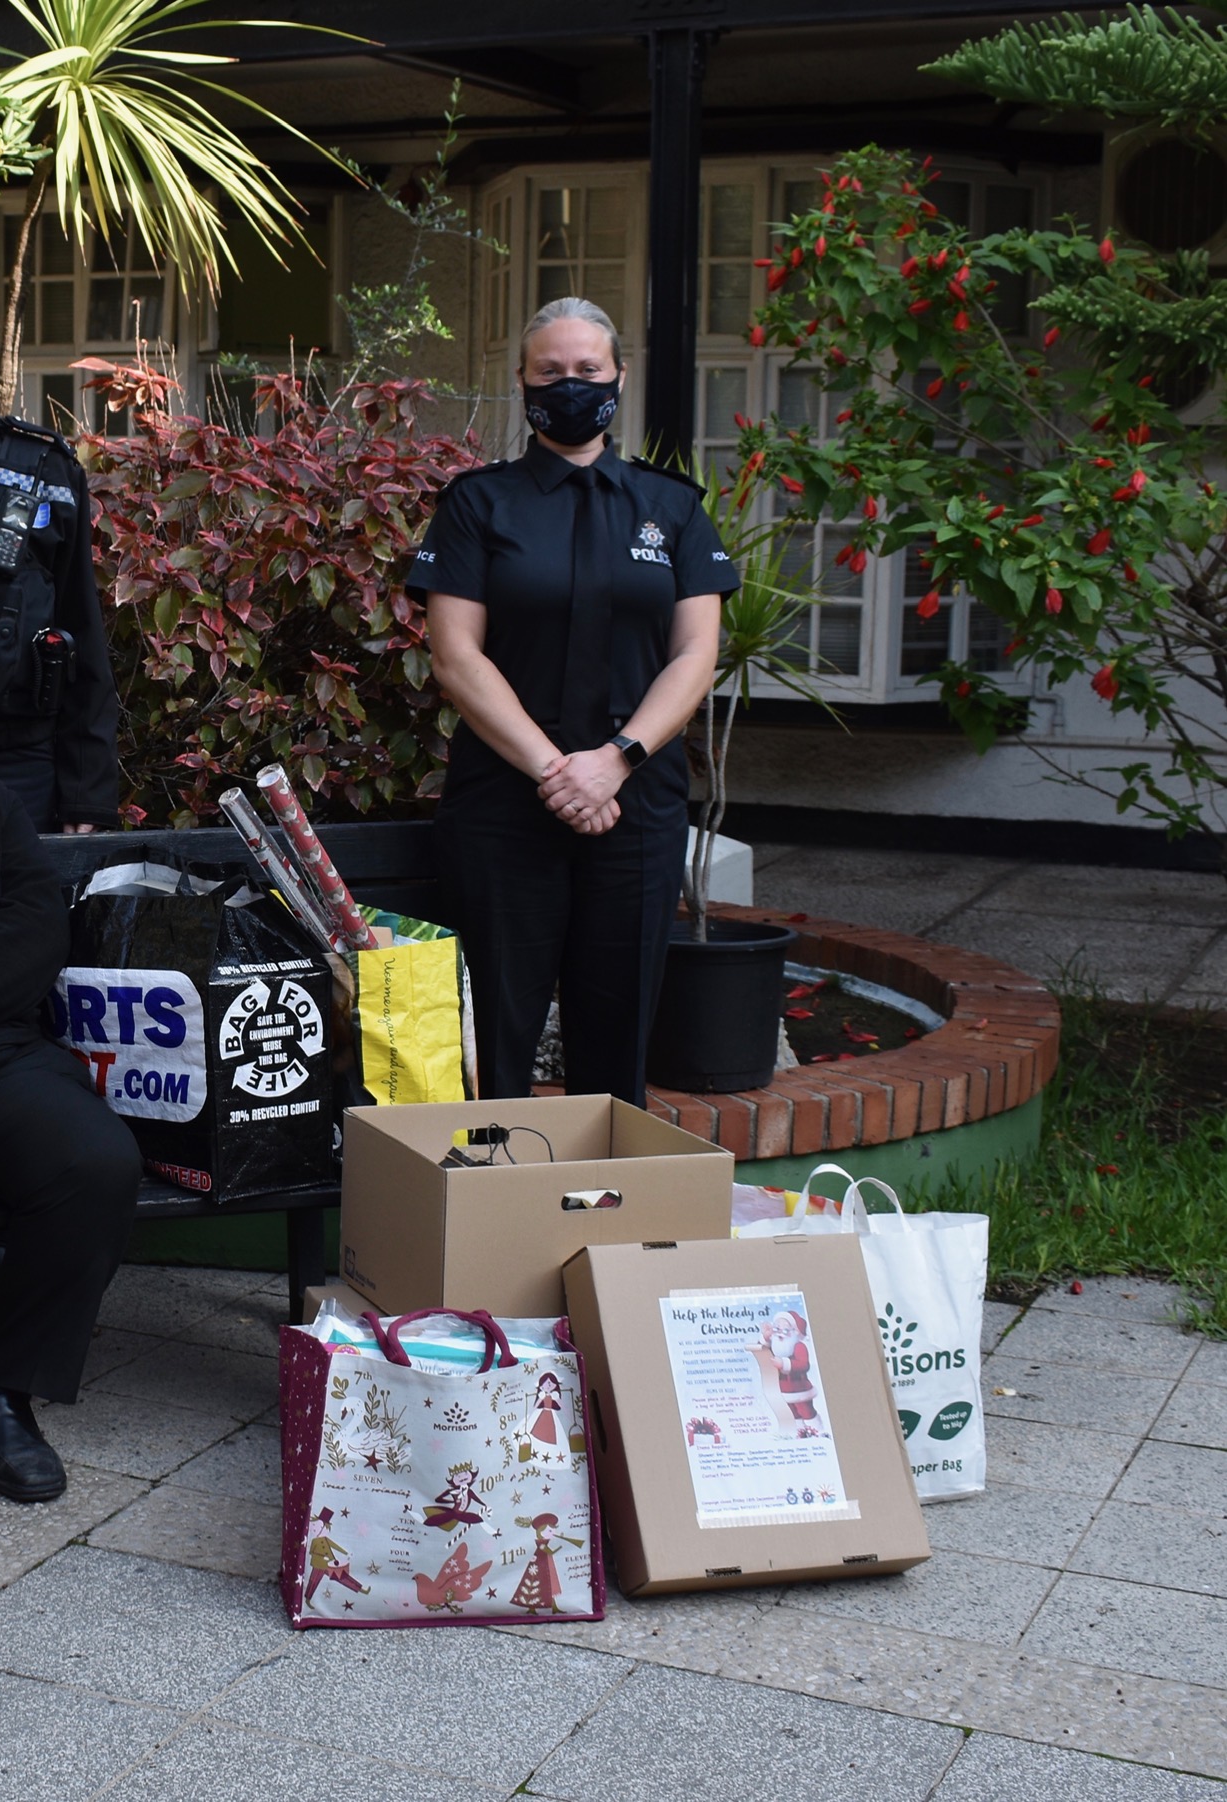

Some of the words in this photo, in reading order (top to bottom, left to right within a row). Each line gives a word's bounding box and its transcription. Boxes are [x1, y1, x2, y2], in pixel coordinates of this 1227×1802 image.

[218, 966, 240, 976] 30%
[240, 962, 279, 974] RECYCLED
[278, 958, 314, 970] CONTENT
[257, 1014, 273, 1026] SAVE
[274, 1012, 286, 1024] THE
[282, 987, 318, 1040] FOR
[225, 994, 258, 1053] BAG
[378, 1008, 395, 1048] again
[249, 1026, 294, 1040] ENVIRONMENT
[262, 1040, 282, 1052] REUSE
[258, 1055, 272, 1066] THIS
[274, 1053, 288, 1064] BAG
[390, 1048, 404, 1069] and
[246, 1062, 304, 1092] LIFE
[381, 1069, 402, 1105] again
[230, 1110, 250, 1123] 30%
[252, 1104, 289, 1121] RECYCLED
[290, 1100, 320, 1116] CONTENT
[672, 1308, 697, 1324] Help
[701, 1308, 719, 1319] the
[721, 1306, 754, 1321] Needy
[758, 1305, 770, 1316] at
[701, 1323, 760, 1335] Christmas
[354, 1371, 373, 1385] 7th
[898, 1379, 915, 1387] 1899
[500, 1412, 517, 1430] 8th
[939, 1411, 959, 1421] Tested
[433, 1423, 477, 1432] Morrisons
[942, 1459, 962, 1472] Bag
[353, 1474, 383, 1484] SEVEN
[479, 1473, 504, 1493] 10th
[501, 1547, 526, 1566] 11th
